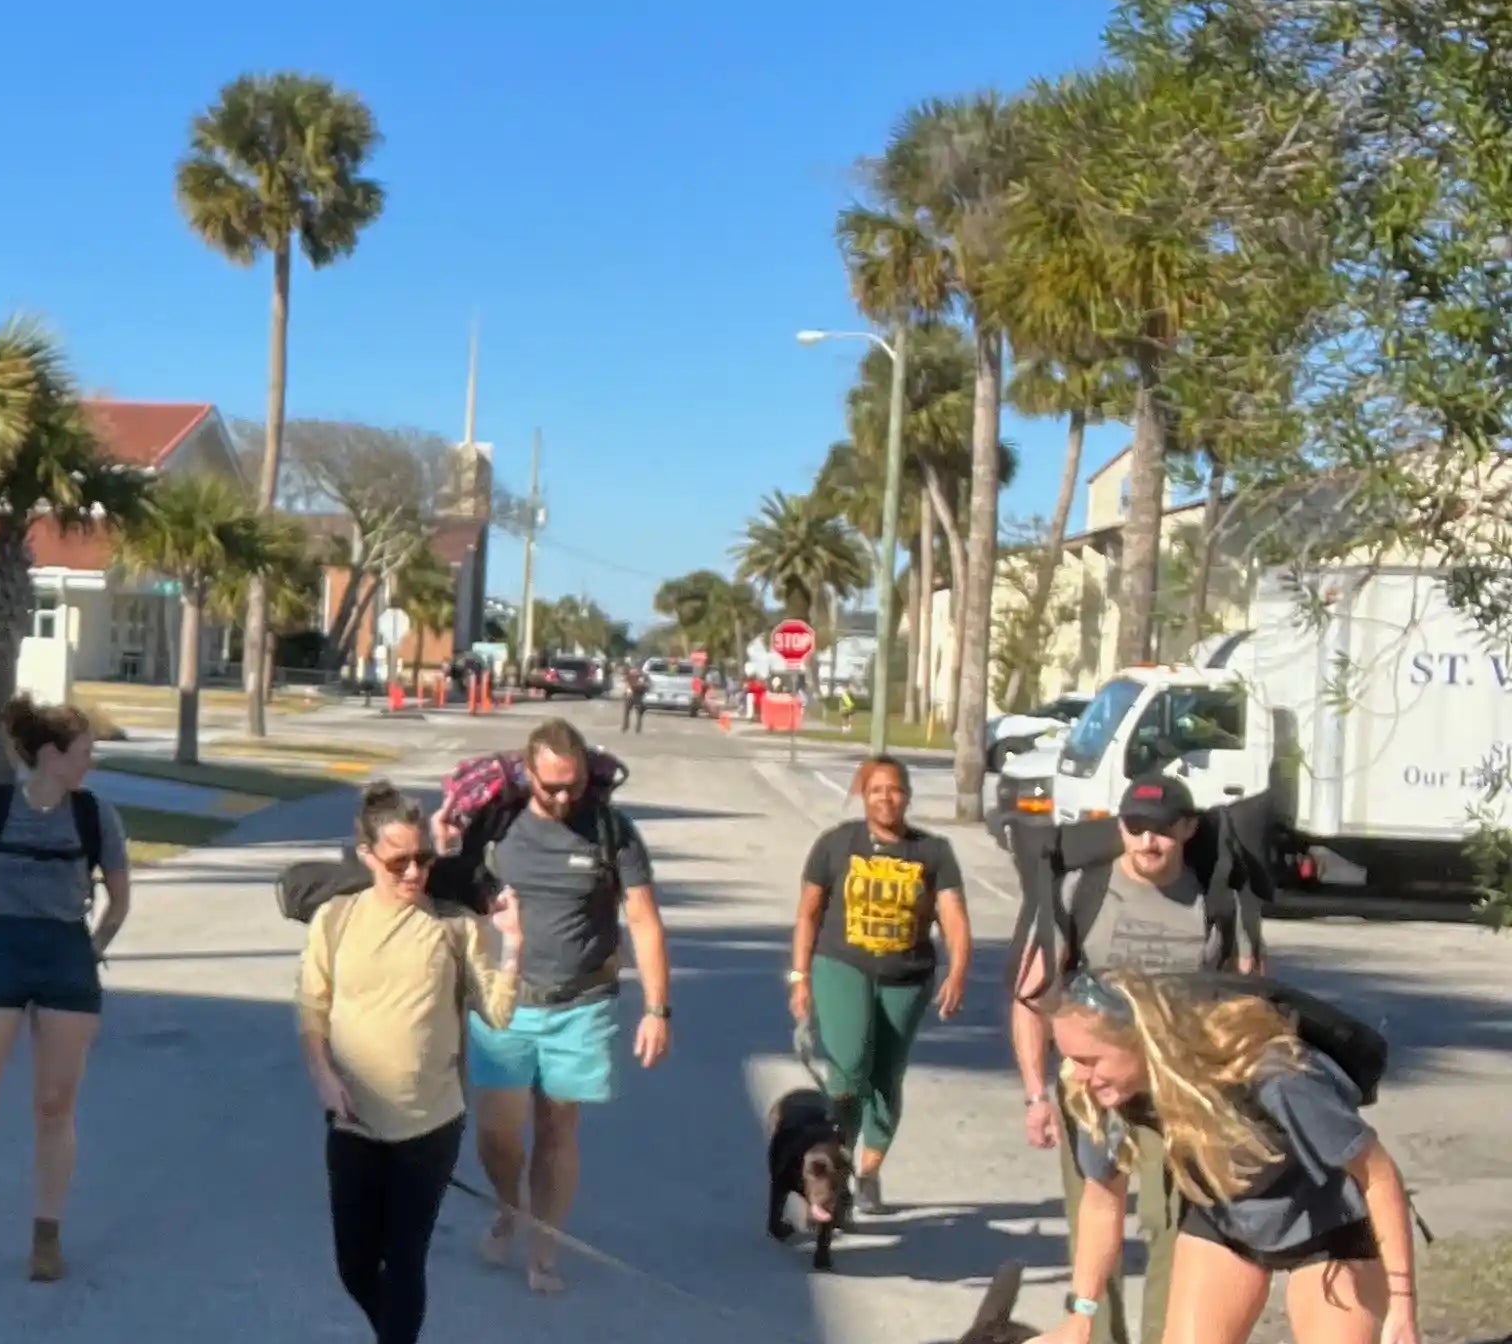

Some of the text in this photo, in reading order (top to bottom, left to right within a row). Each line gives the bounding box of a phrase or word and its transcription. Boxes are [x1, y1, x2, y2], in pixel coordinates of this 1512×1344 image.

[774, 632, 810, 650] STOP
[1410, 651, 1474, 685] ST.
[1403, 765, 1450, 786] Our
